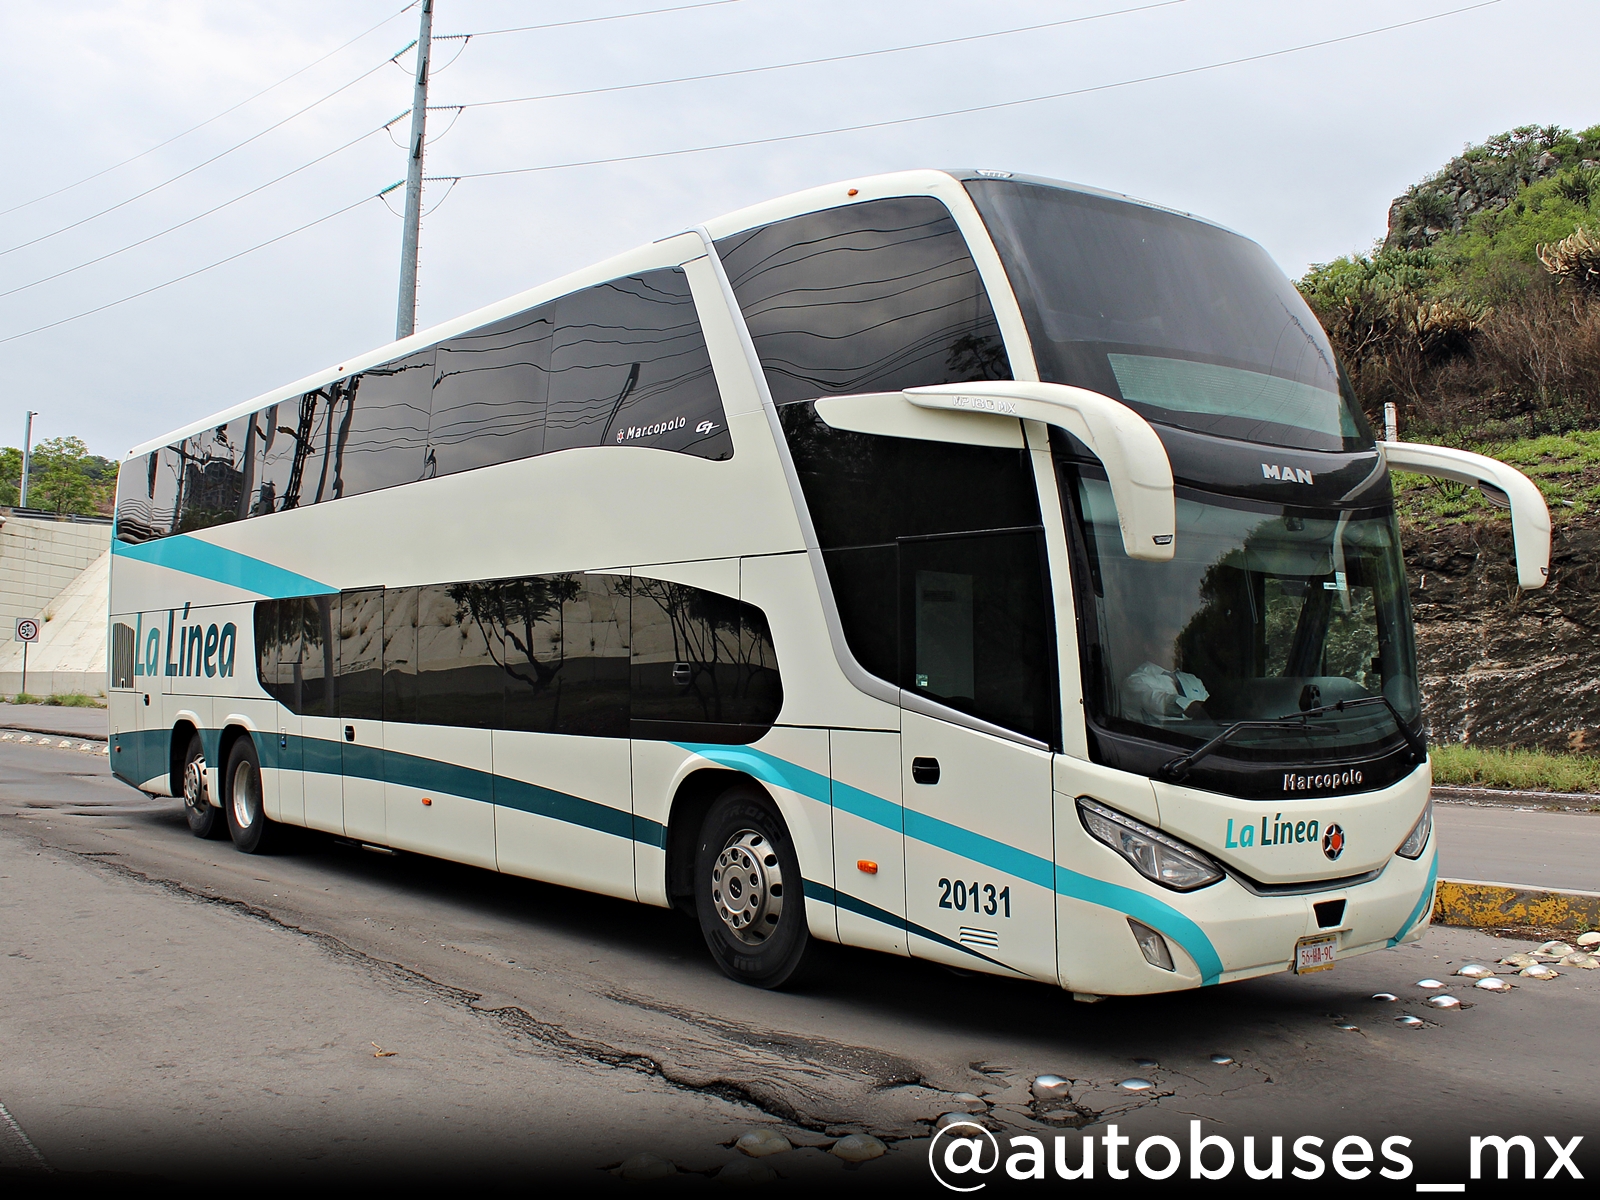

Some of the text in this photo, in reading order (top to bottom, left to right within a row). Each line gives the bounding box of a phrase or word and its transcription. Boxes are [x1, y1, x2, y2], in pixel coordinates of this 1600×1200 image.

[627, 416, 686, 439] Marcopolo
[1261, 463, 1313, 485] MAN
[135, 602, 237, 678] La Línea
[1284, 769, 1363, 791] Marcopolo
[1225, 813, 1319, 849] La Línea
[938, 878, 1012, 918] 20131
